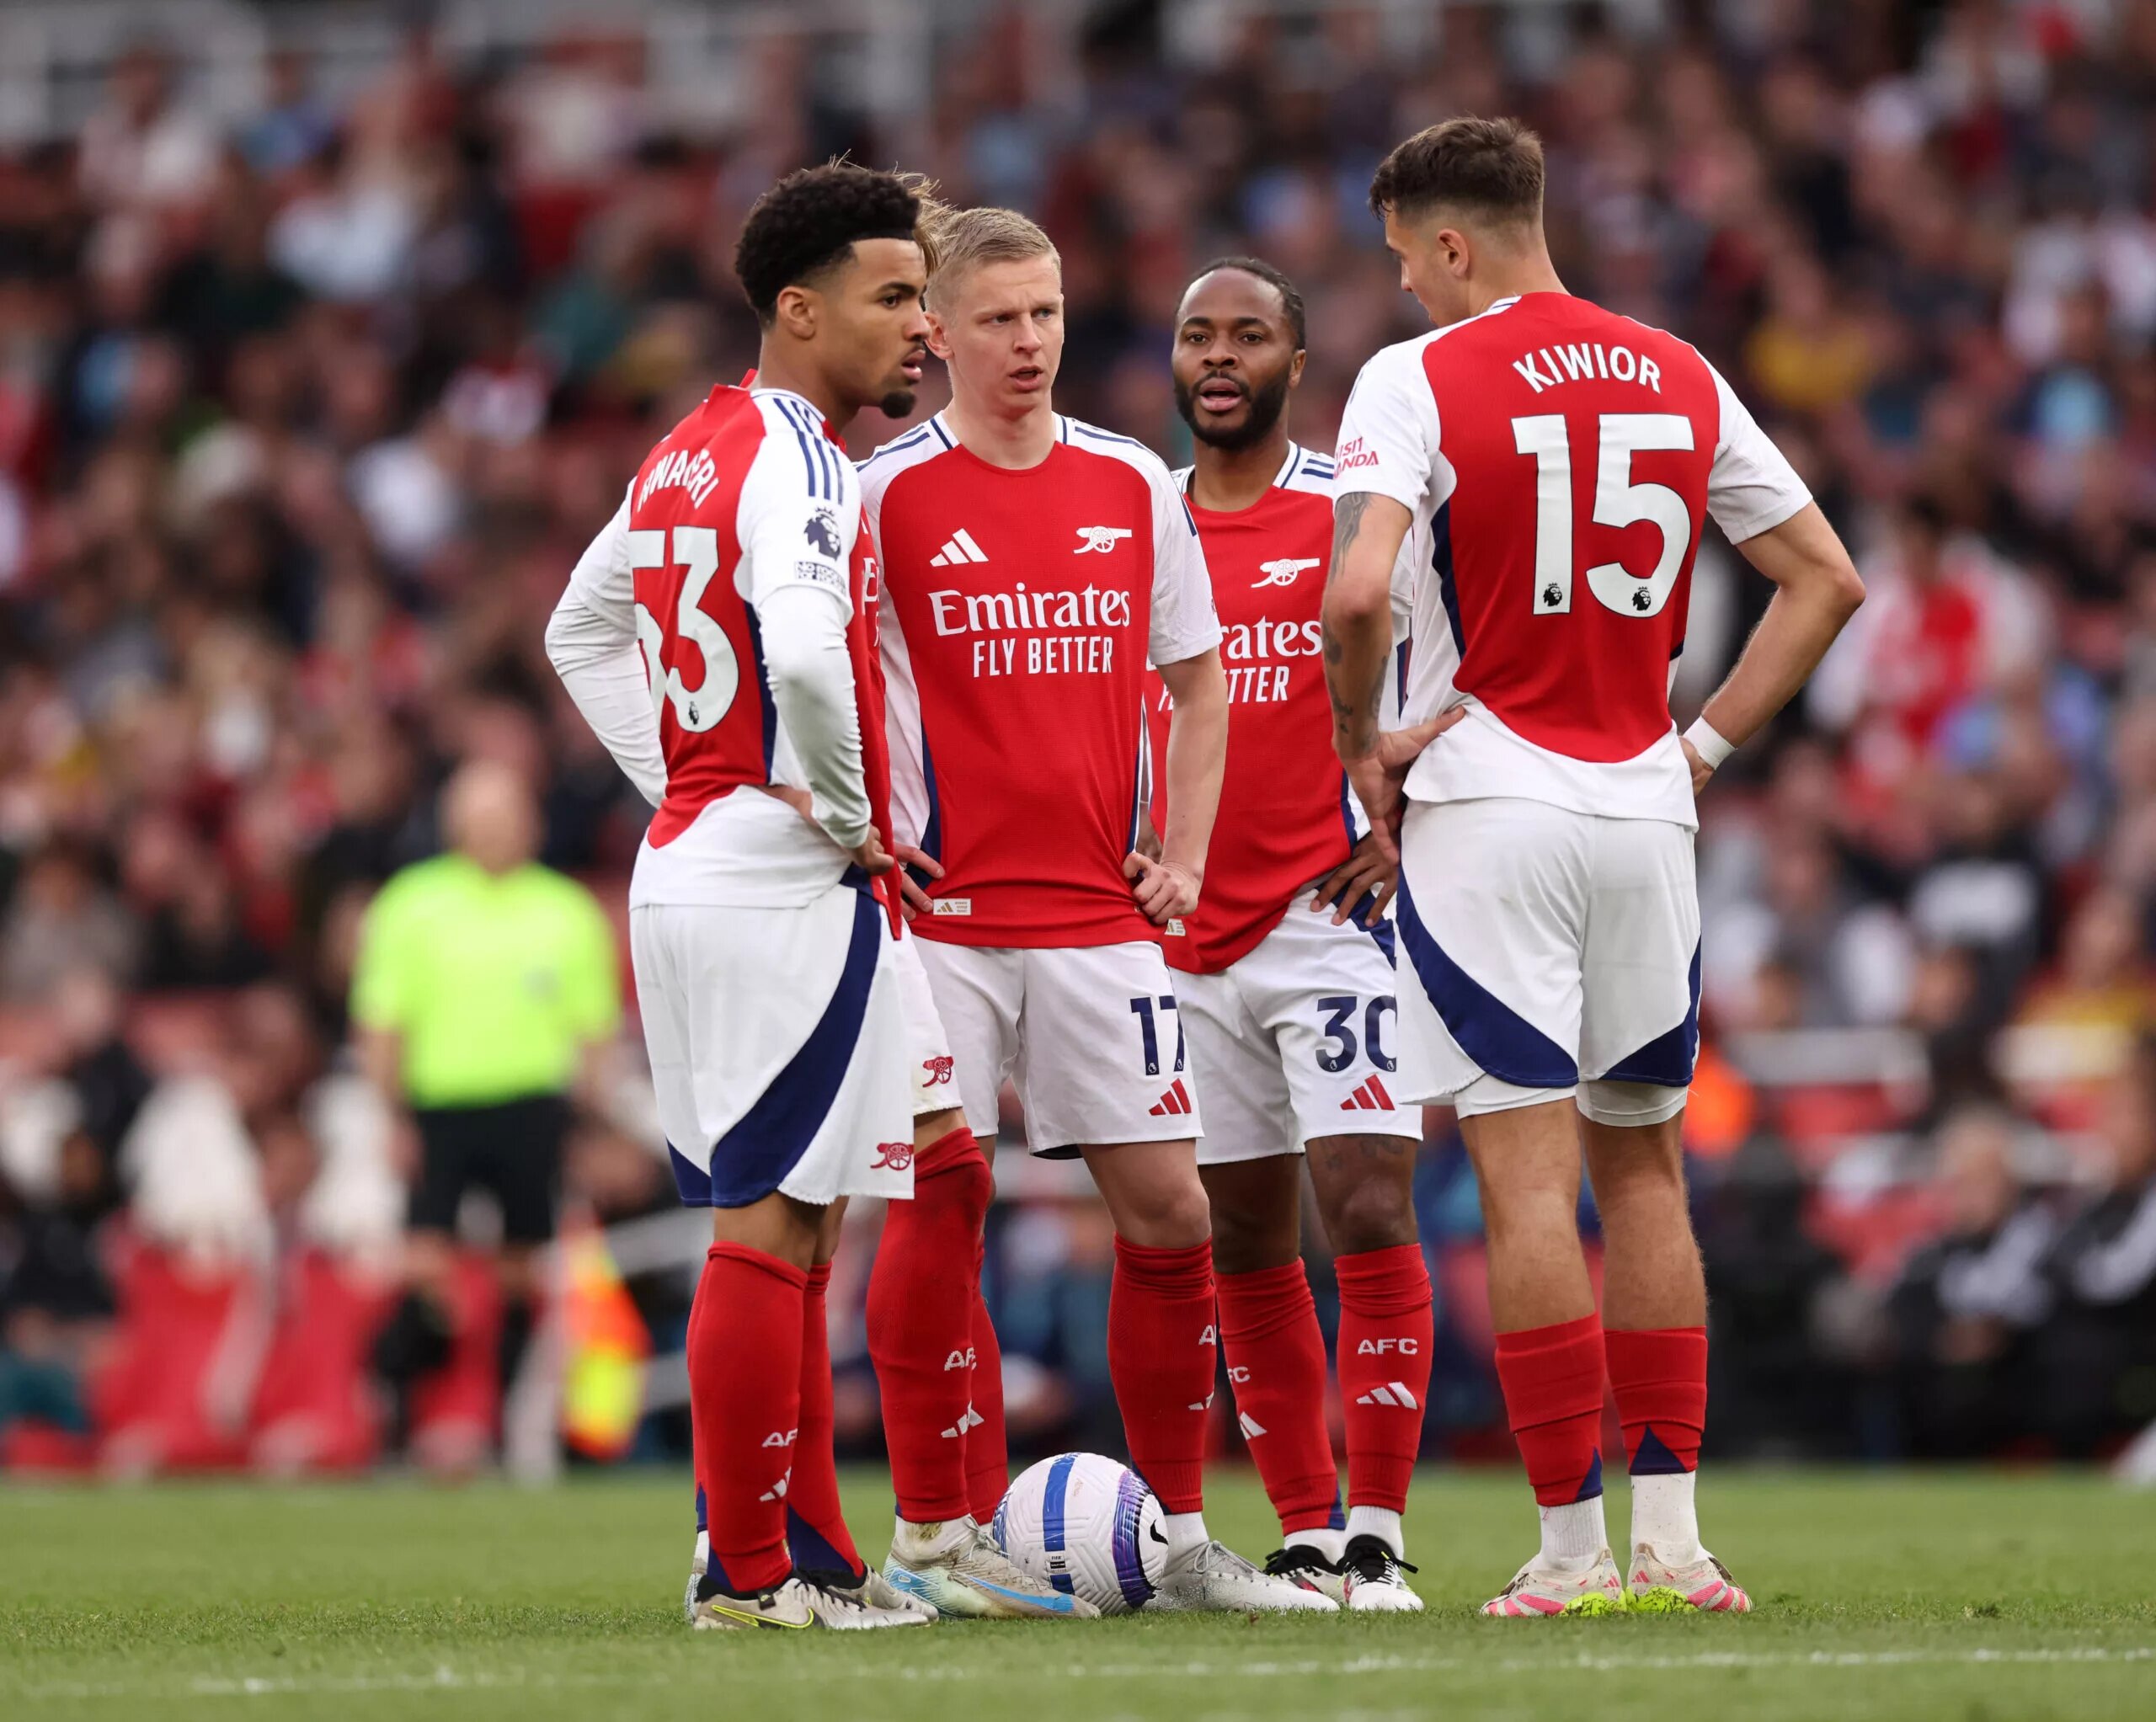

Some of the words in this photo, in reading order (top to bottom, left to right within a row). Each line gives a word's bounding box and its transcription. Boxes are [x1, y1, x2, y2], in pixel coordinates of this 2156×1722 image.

[1513, 343, 1661, 393] KIWIOR
[1511, 413, 1694, 618] 15
[628, 526, 739, 733] 53
[928, 582, 1130, 637] Emirates
[974, 637, 1016, 678] FLY
[1027, 636, 1113, 674] BETTER
[1224, 665, 1290, 704] TTER
[1130, 995, 1185, 1076] 17
[1315, 995, 1397, 1073] 30
[1358, 1338, 1418, 1355] AFC
[762, 1428, 798, 1447] AF
